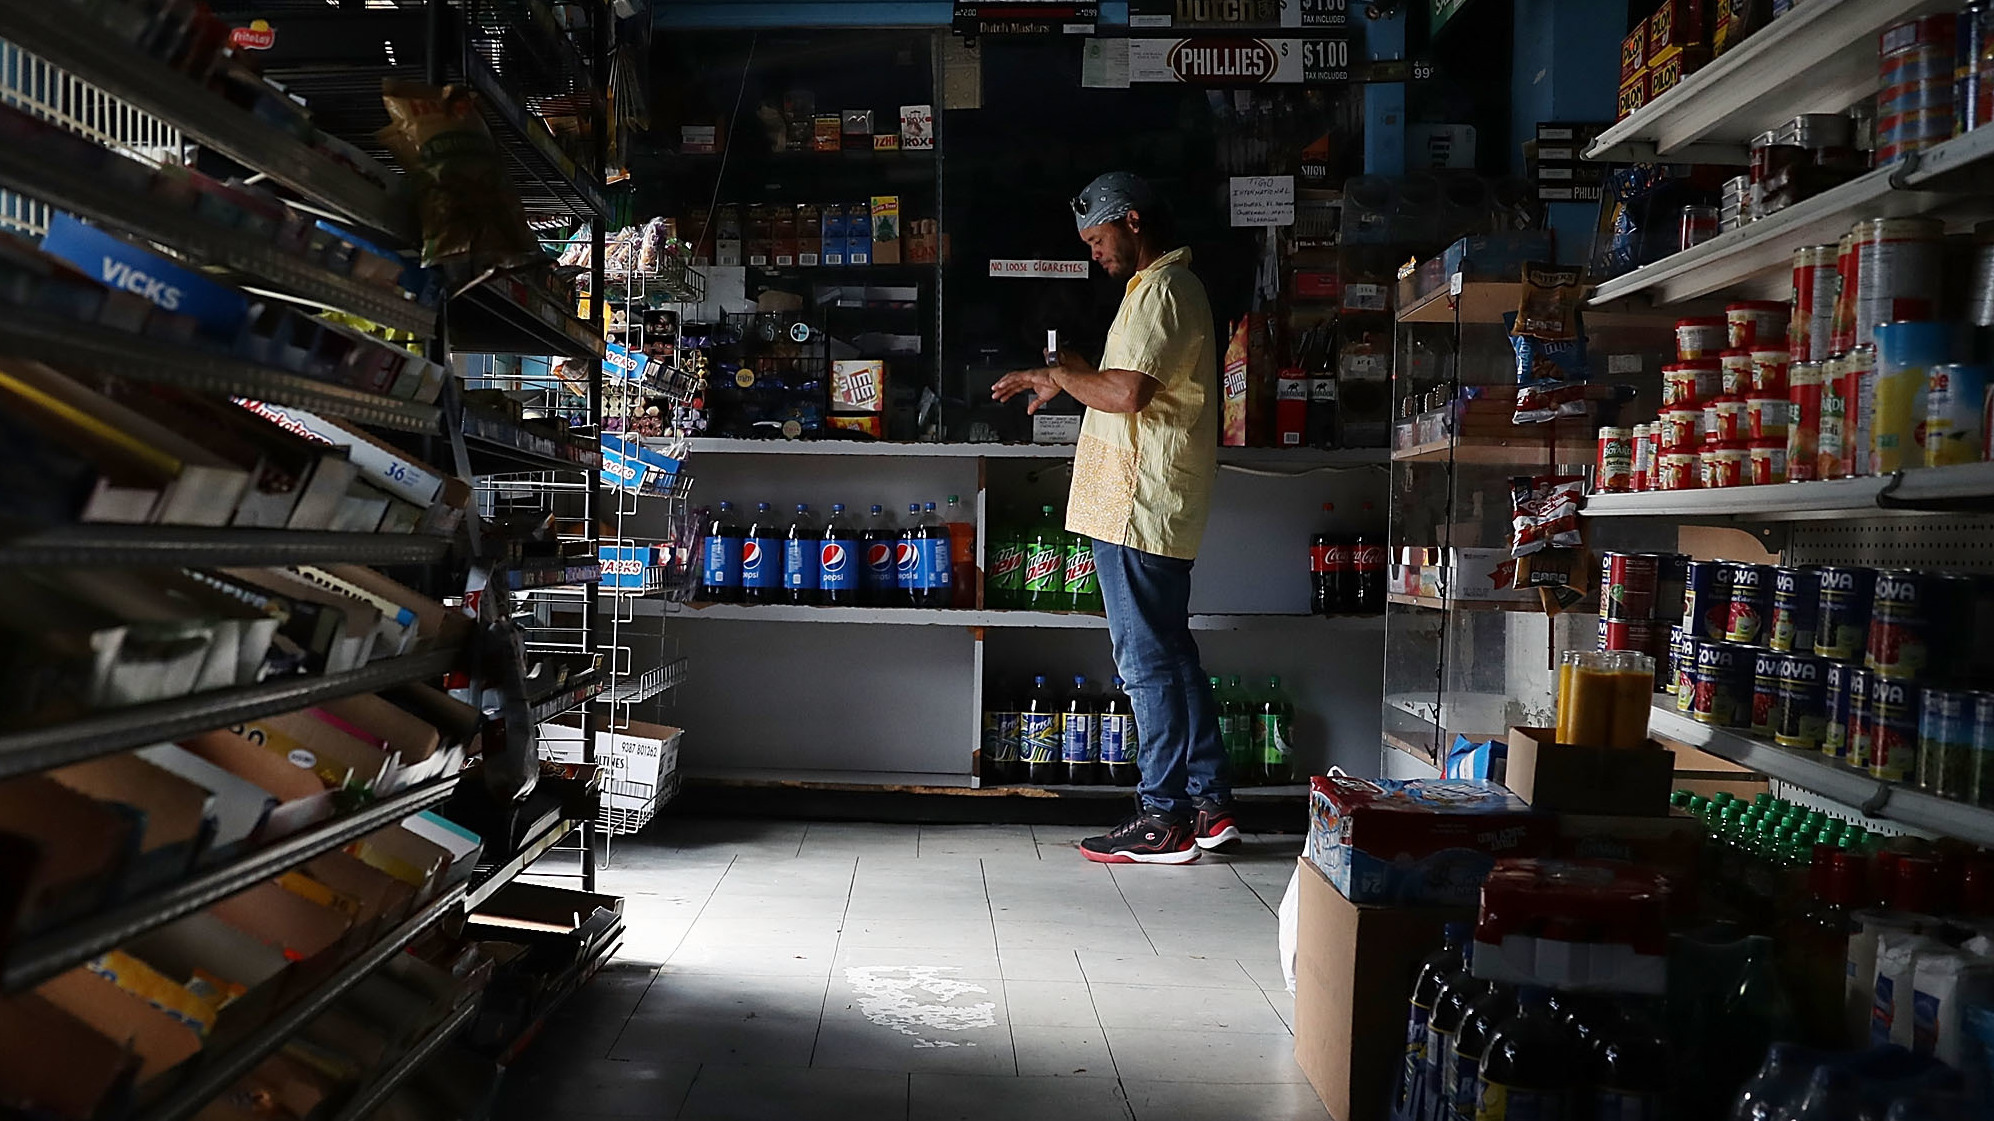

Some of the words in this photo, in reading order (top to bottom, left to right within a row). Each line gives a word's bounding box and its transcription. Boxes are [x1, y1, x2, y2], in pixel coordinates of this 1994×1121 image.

[1303, 15, 1315, 24] TAX
[1316, 15, 1345, 24] INCLUDED
[979, 22, 1009, 34] Dutch
[1181, 48, 1265, 76] PHILLIES
[1305, 72, 1317, 80] TAX
[1318, 72, 1348, 80] INCLUDED
[904, 137, 928, 147] ROX
[991, 262, 1002, 271] NO
[1005, 262, 1028, 272] LOOSE
[101, 255, 181, 311] VICKS
[384, 462, 405, 482] 36
[823, 573, 844, 582] pepsi
